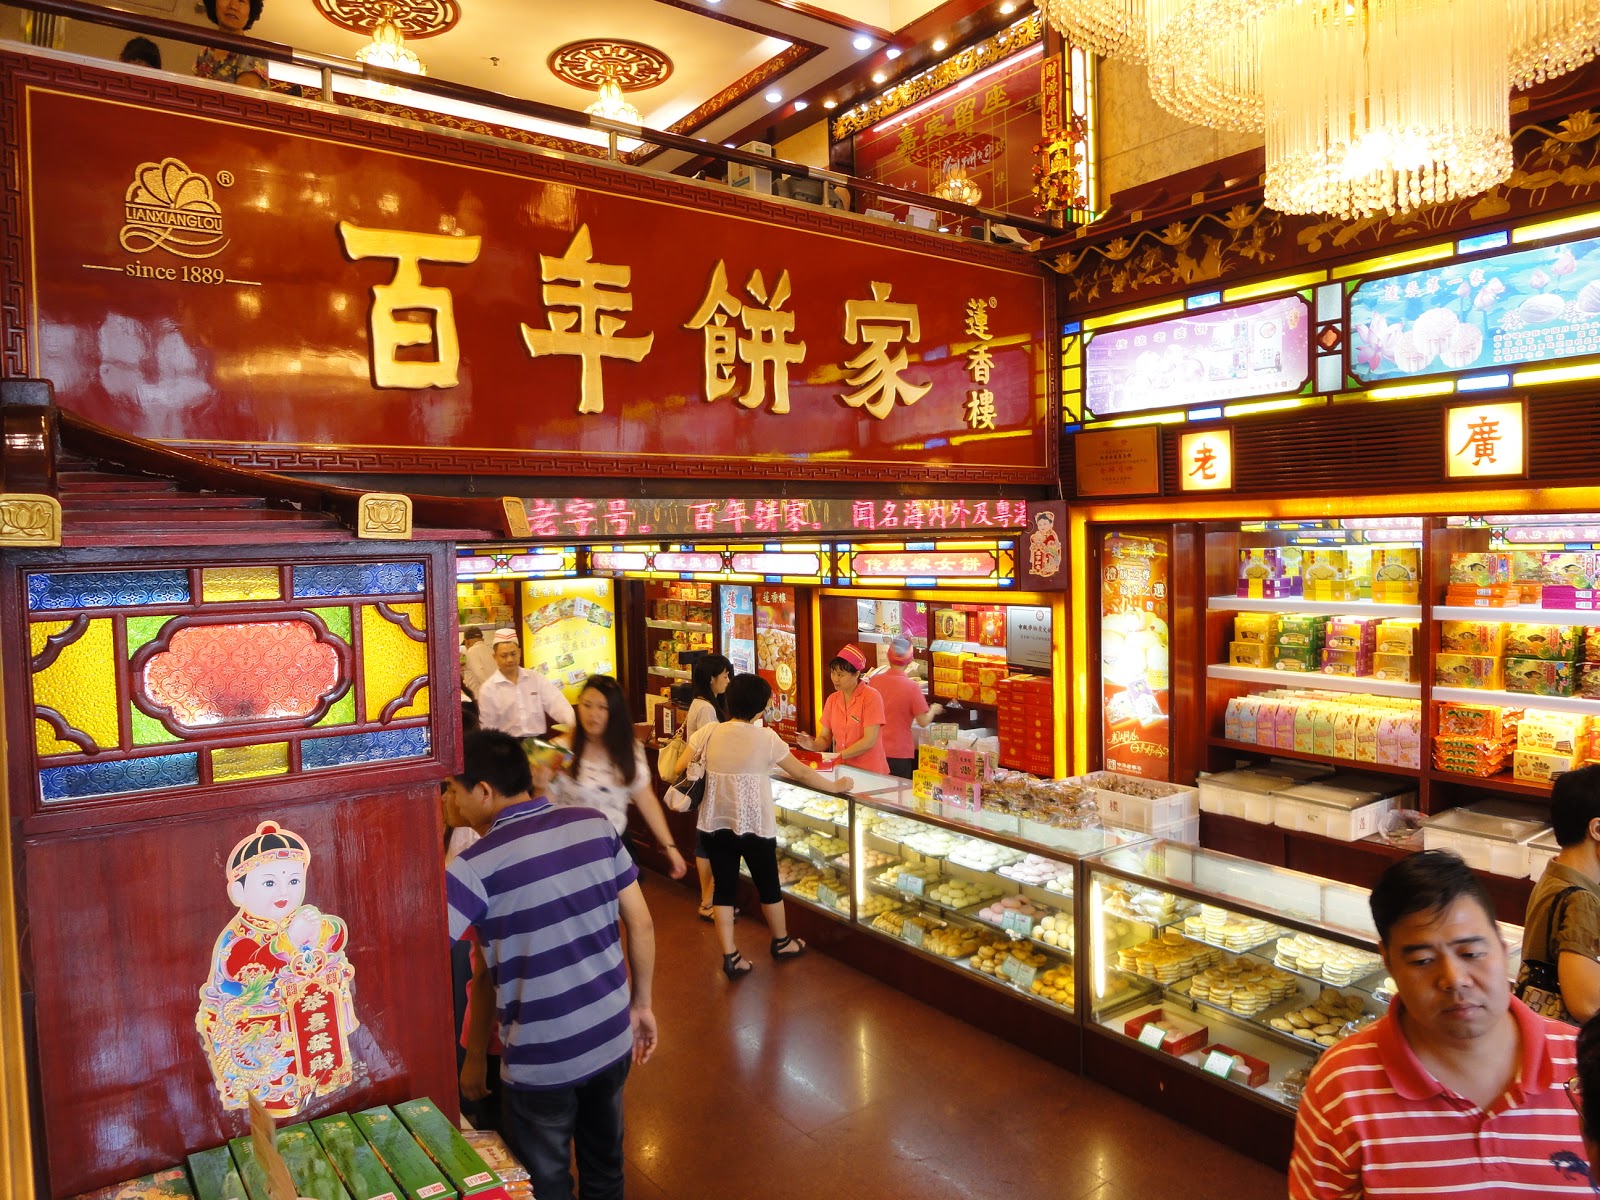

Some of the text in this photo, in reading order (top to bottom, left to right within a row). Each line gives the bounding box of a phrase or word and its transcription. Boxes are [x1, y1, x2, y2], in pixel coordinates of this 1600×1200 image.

[125, 206, 223, 231] LIANXIANGLOU
[125, 260, 225, 285] since 1889
[338, 220, 933, 420] 百年餅家
[963, 298, 996, 430] 蓮香樓
[1188, 415, 1503, 480] 老 廣
